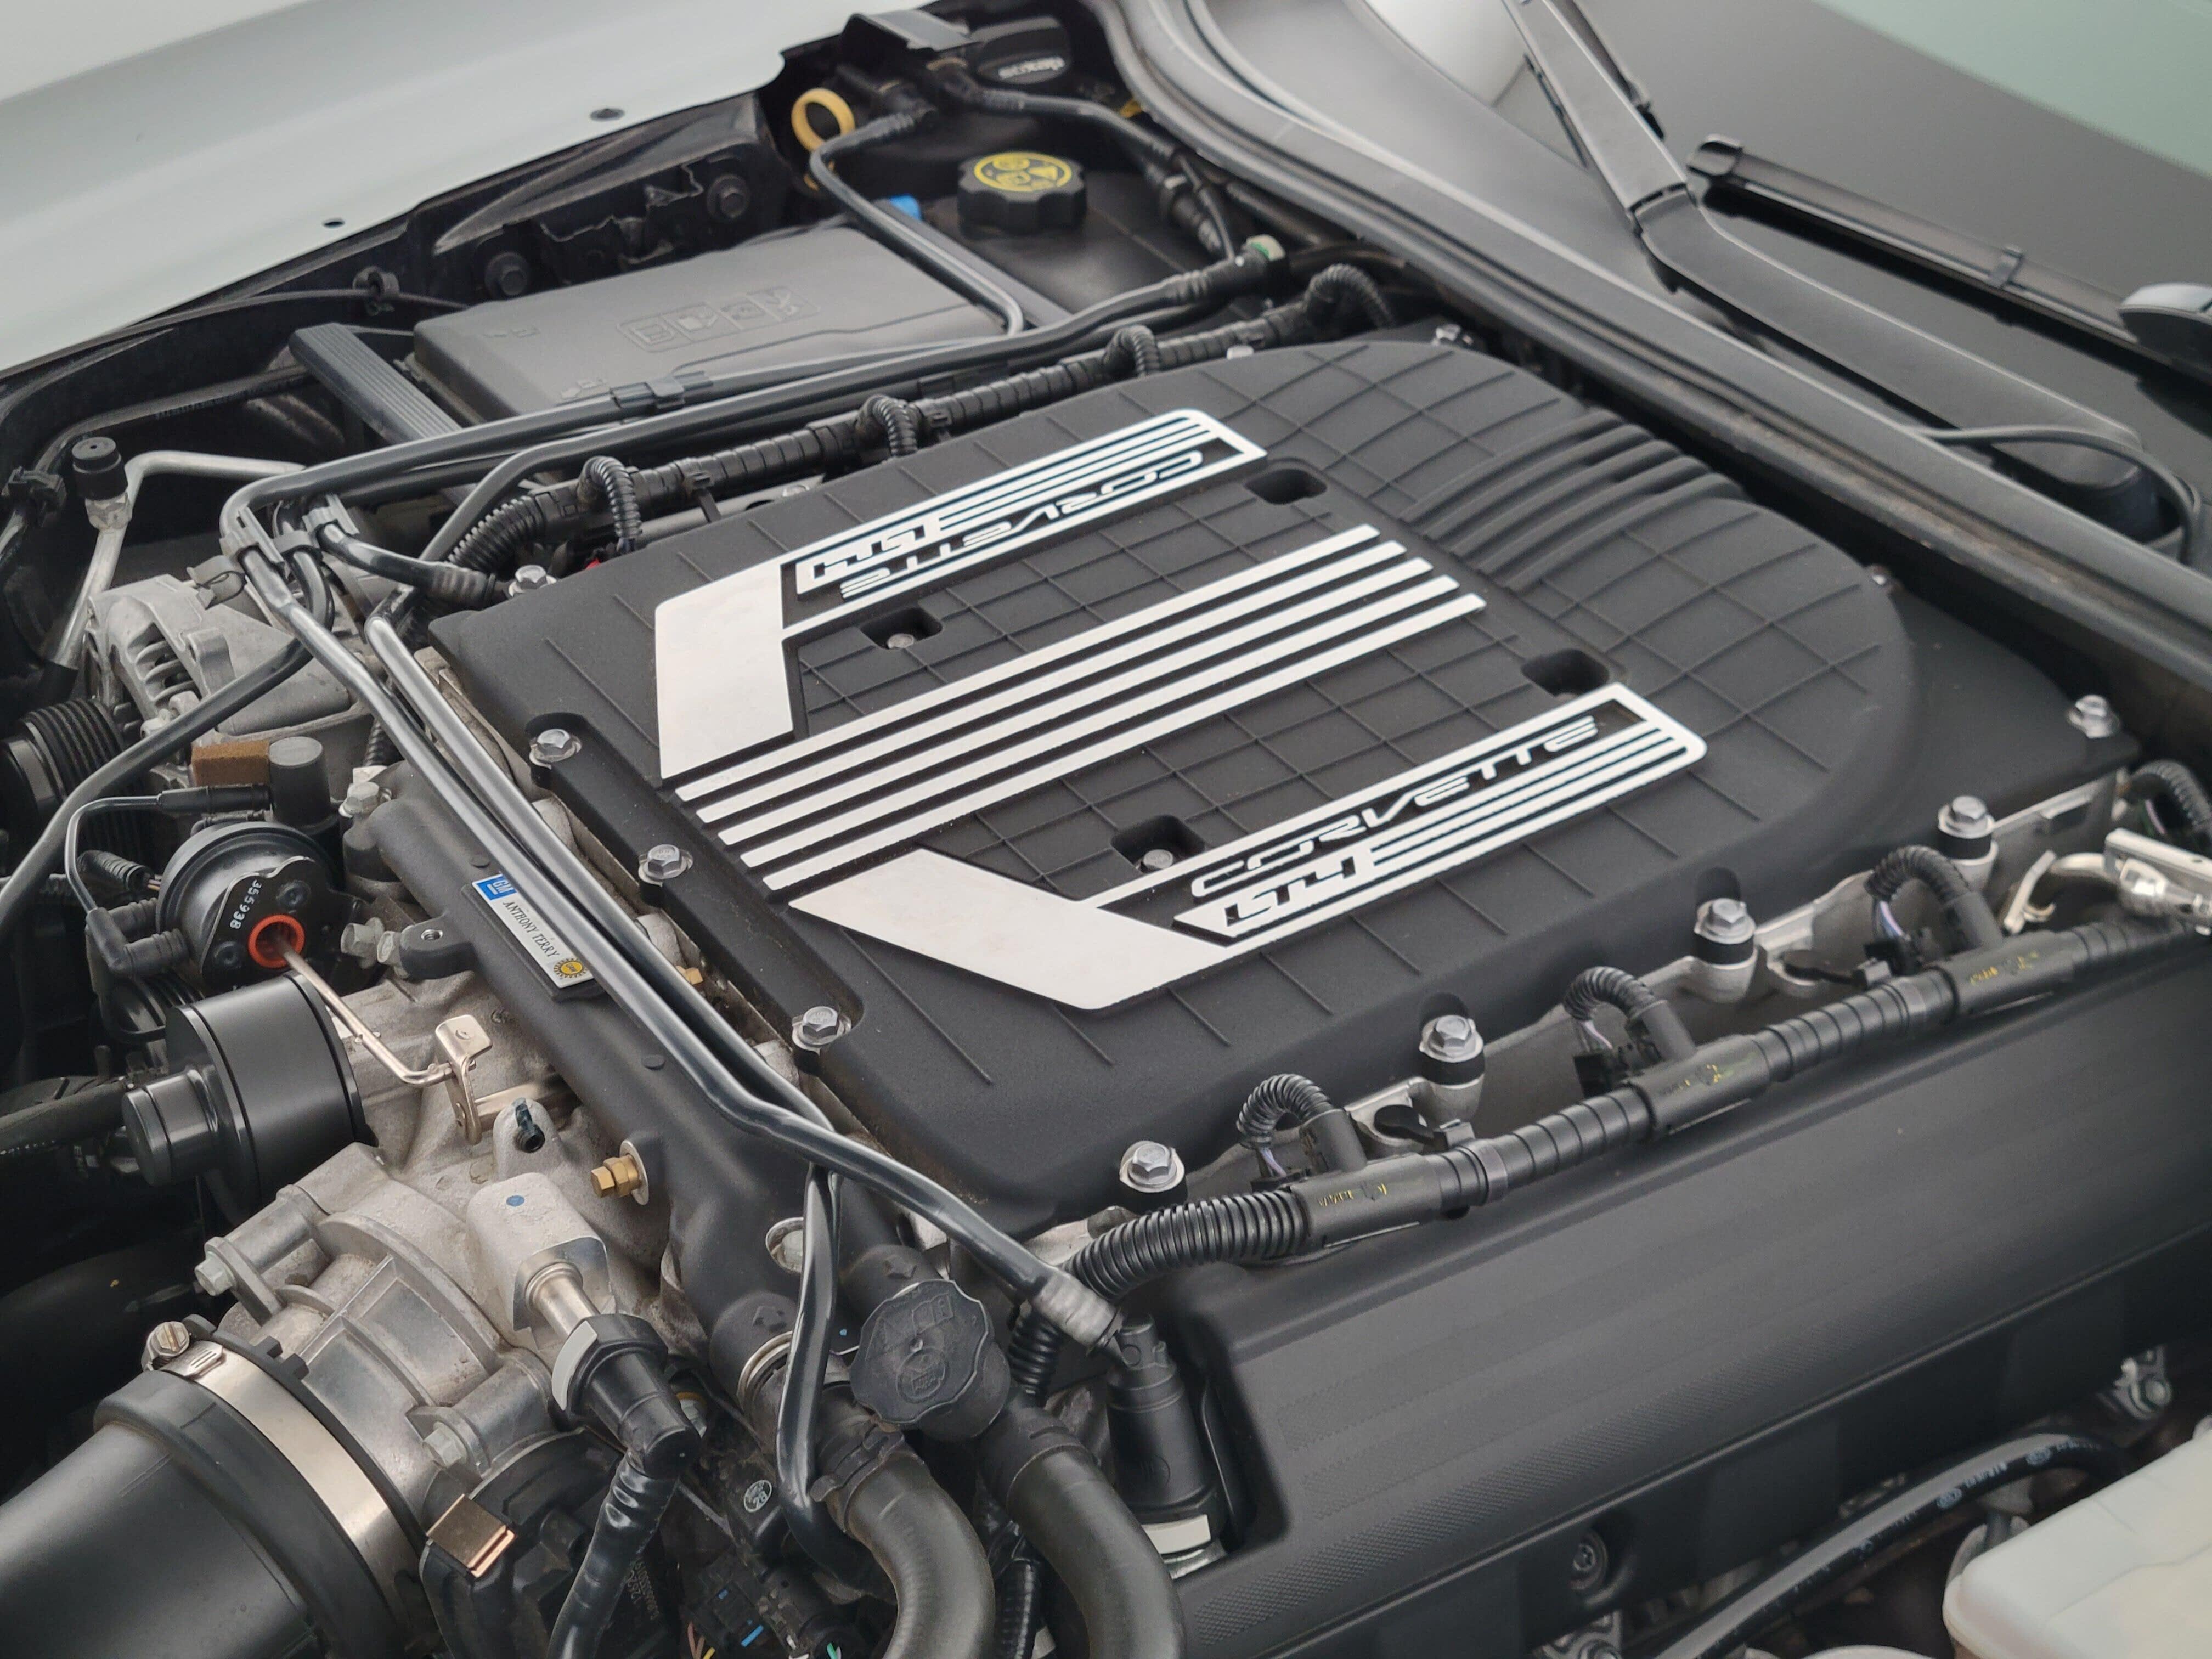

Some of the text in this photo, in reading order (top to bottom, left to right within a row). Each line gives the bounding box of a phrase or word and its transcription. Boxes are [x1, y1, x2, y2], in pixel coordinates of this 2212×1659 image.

[839, 450, 1204, 599] CORVETTE
[1190, 715, 1599, 898] CORVETTE
[229, 879, 262, 929] 355938
[493, 878, 514, 894] GM
[503, 901, 560, 957] ANTHONY TERRY
